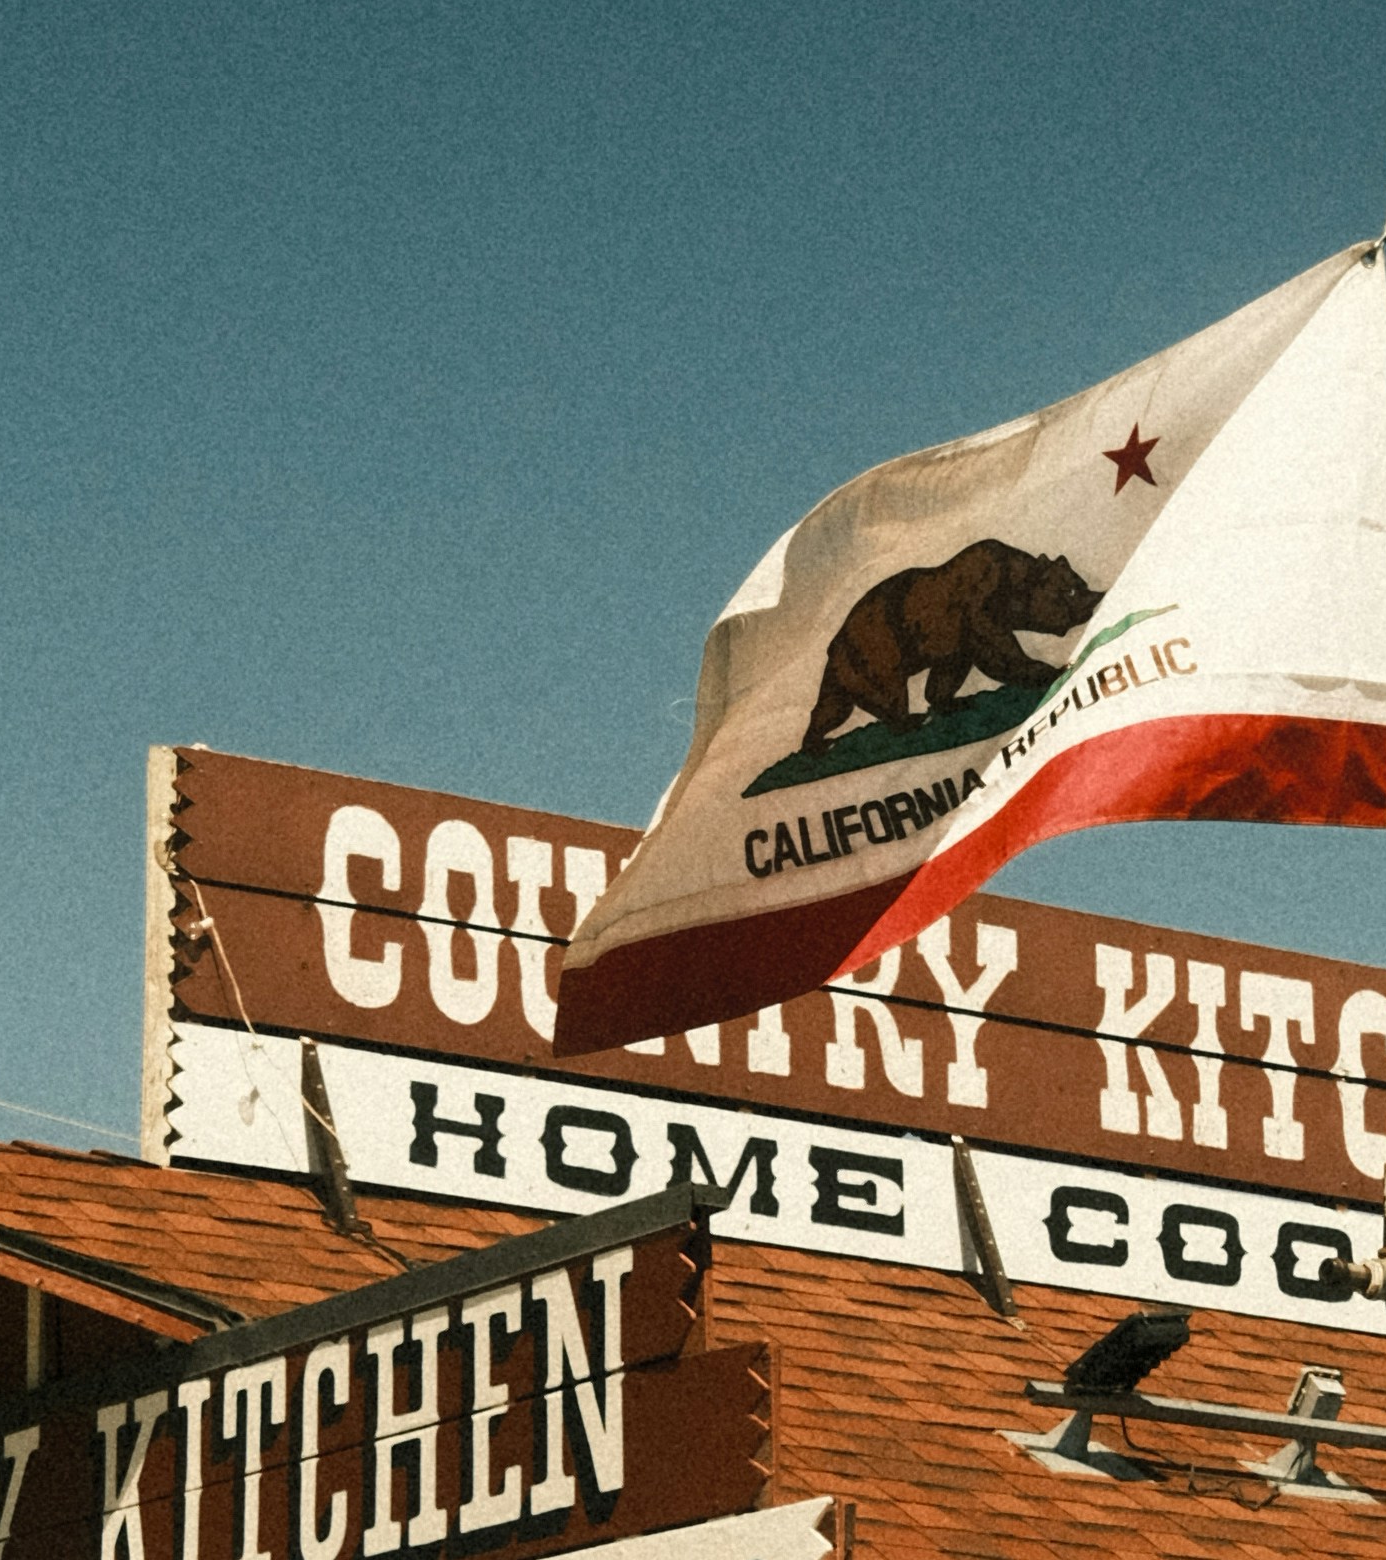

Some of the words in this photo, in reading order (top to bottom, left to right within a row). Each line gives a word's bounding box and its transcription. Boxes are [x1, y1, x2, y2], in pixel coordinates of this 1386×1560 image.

[744, 768, 986, 878] CALIFORNIA
[1001, 638, 1197, 768] REPUBLIC
[315, 804, 1018, 1109] COURY
[408, 1080, 904, 1237] HOME
